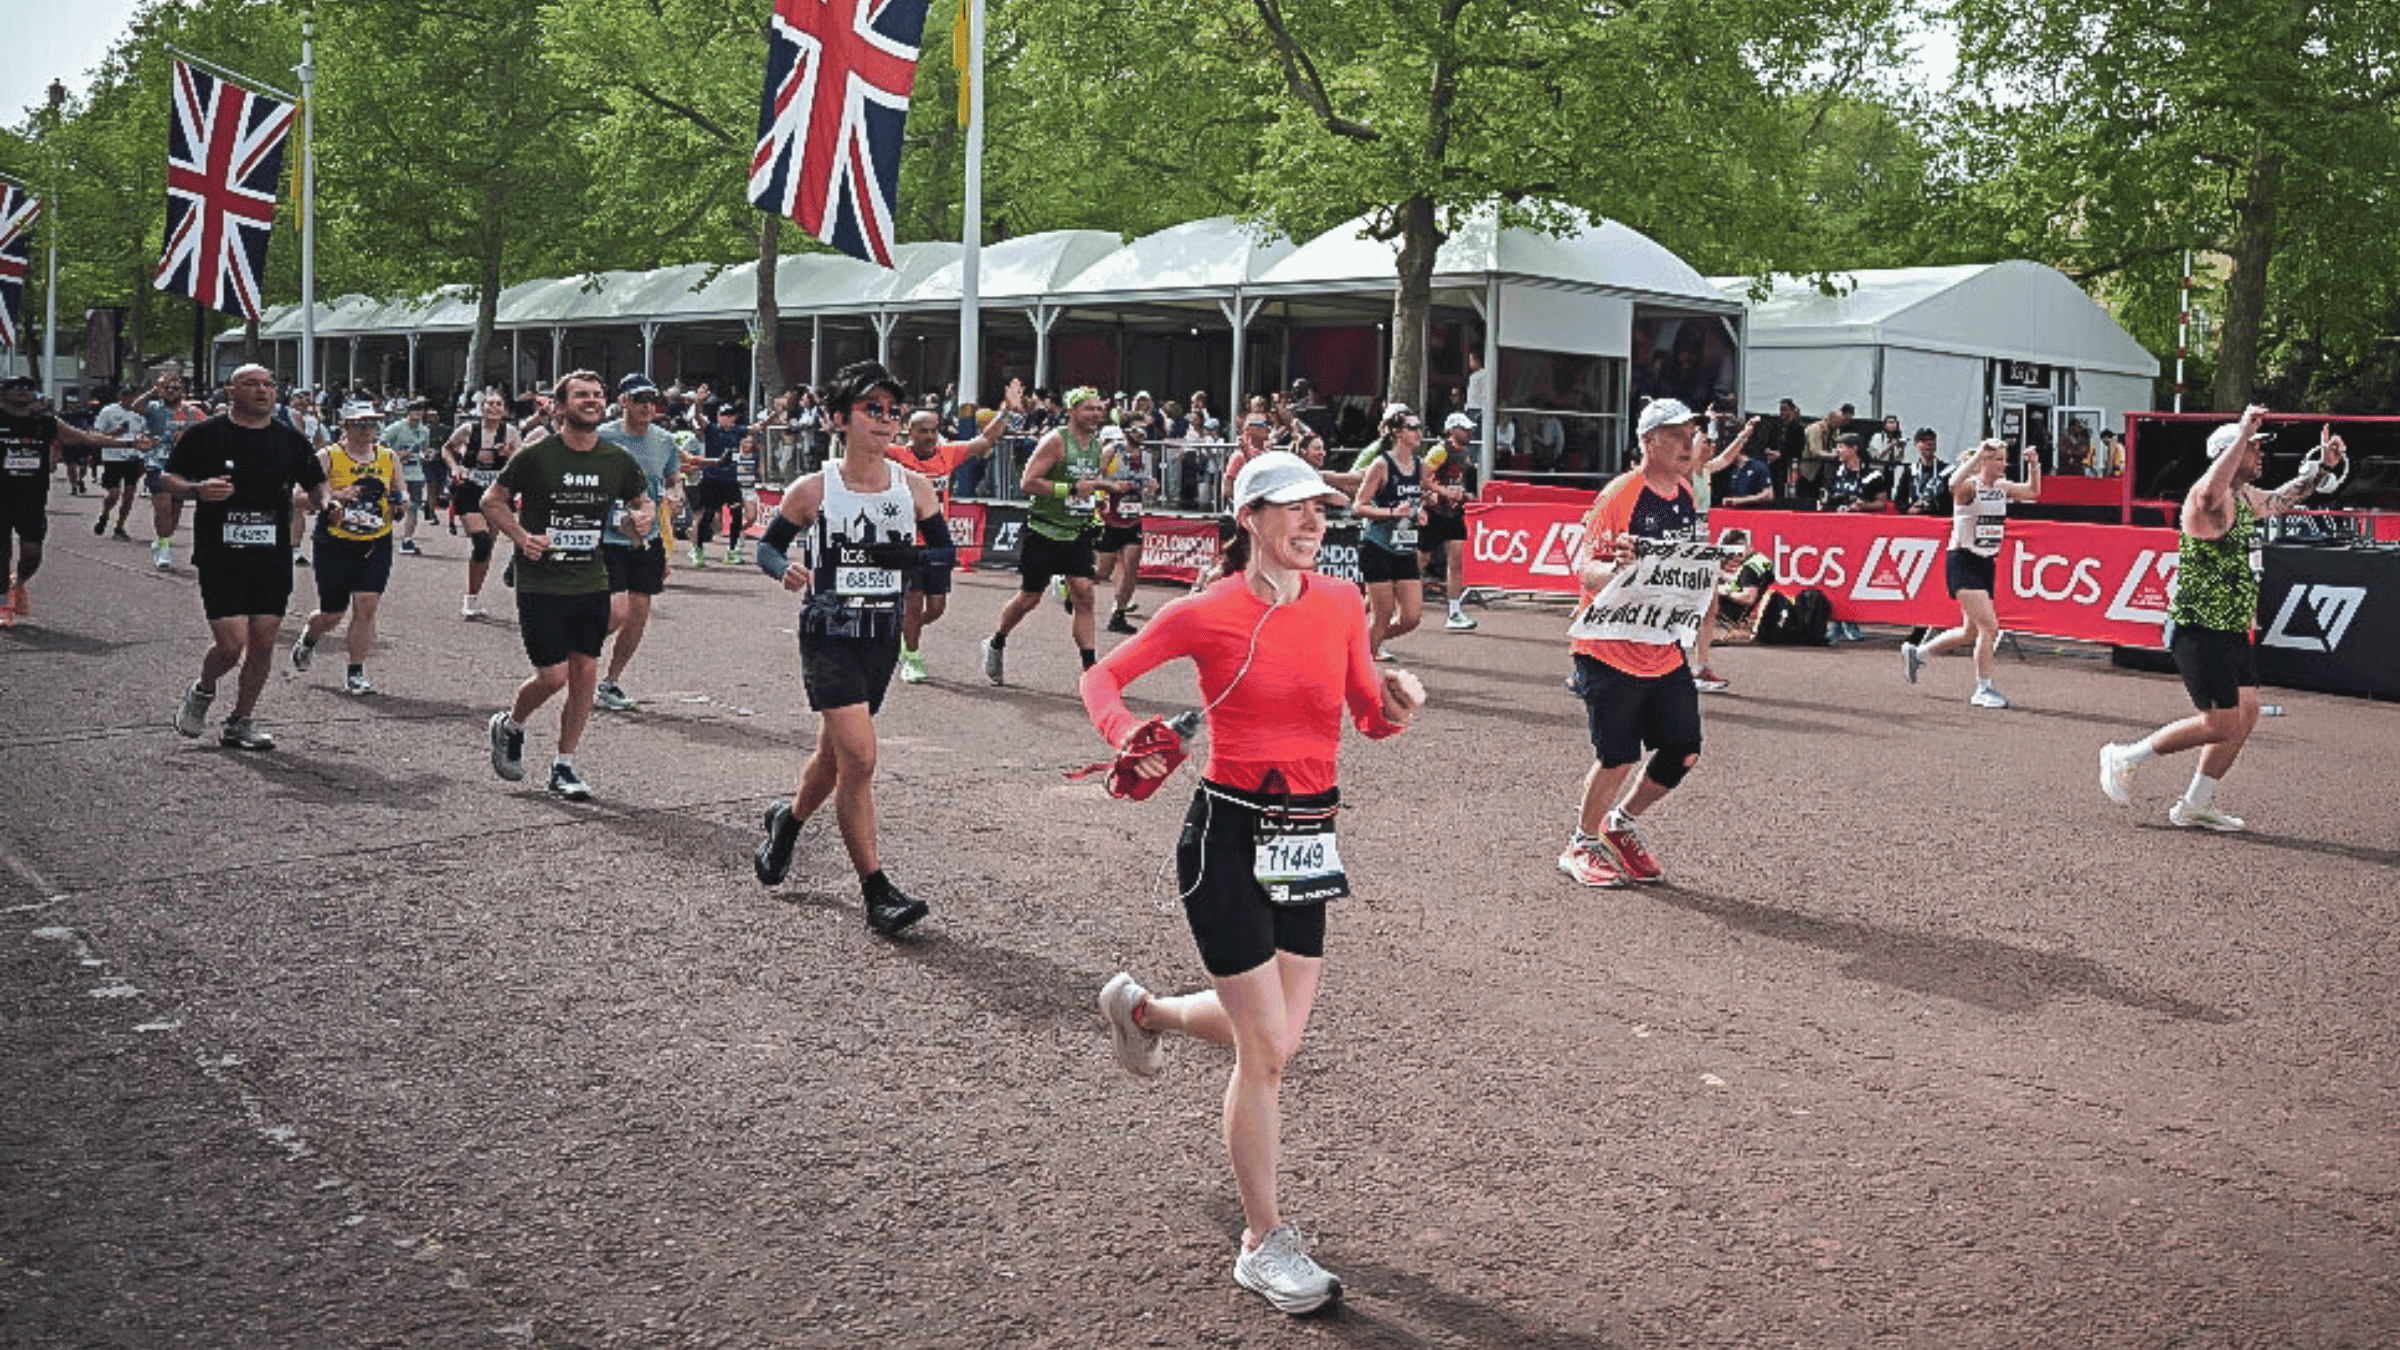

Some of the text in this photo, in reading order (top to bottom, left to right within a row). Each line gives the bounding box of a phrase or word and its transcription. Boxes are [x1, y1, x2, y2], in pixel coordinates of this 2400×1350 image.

[1474, 520, 1529, 563] tcs
[1774, 535, 1846, 587] tcs
[846, 571, 895, 589] 68590
[2013, 540, 2101, 604] tcs
[1267, 843, 1324, 871] 71449
